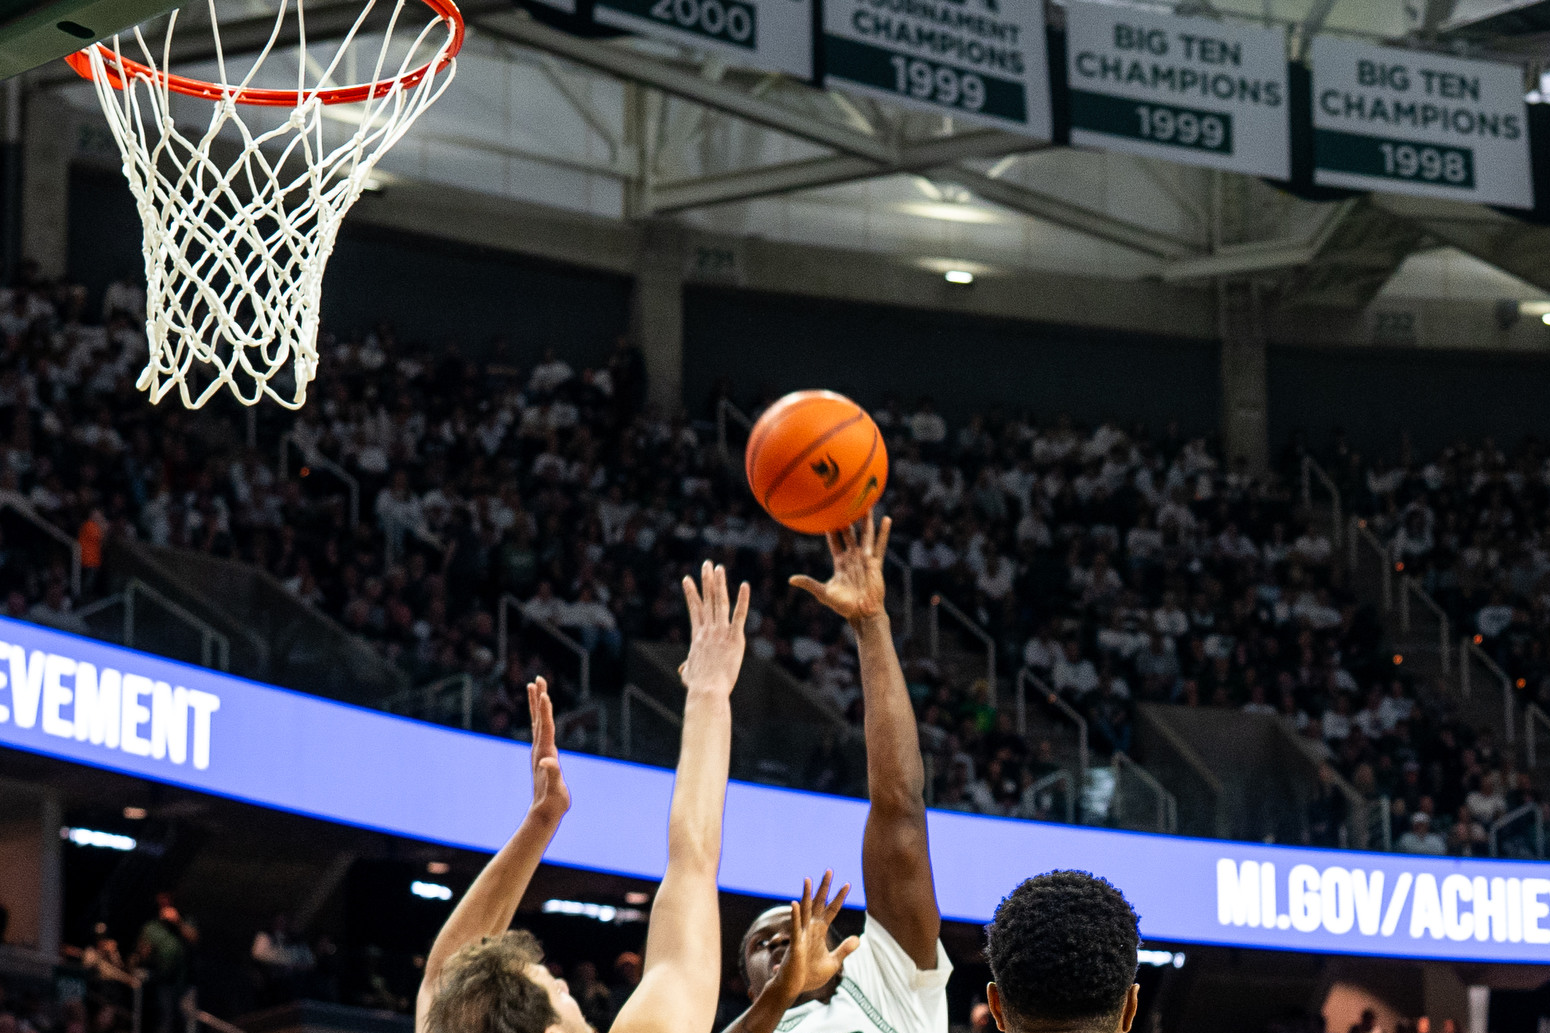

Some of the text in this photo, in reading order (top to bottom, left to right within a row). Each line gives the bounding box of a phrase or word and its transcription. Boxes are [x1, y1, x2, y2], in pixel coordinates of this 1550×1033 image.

[853, 9, 1025, 75] CHAMPIONS
[1113, 23, 1242, 67] BIG TEN
[891, 55, 988, 110] 1999
[1075, 51, 1283, 107] CHAMPIONS
[1357, 59, 1481, 101] BIG TEN
[1135, 106, 1225, 149] 1999
[1319, 89, 1521, 140] CHAMPIONS
[1380, 143, 1467, 181] 1998
